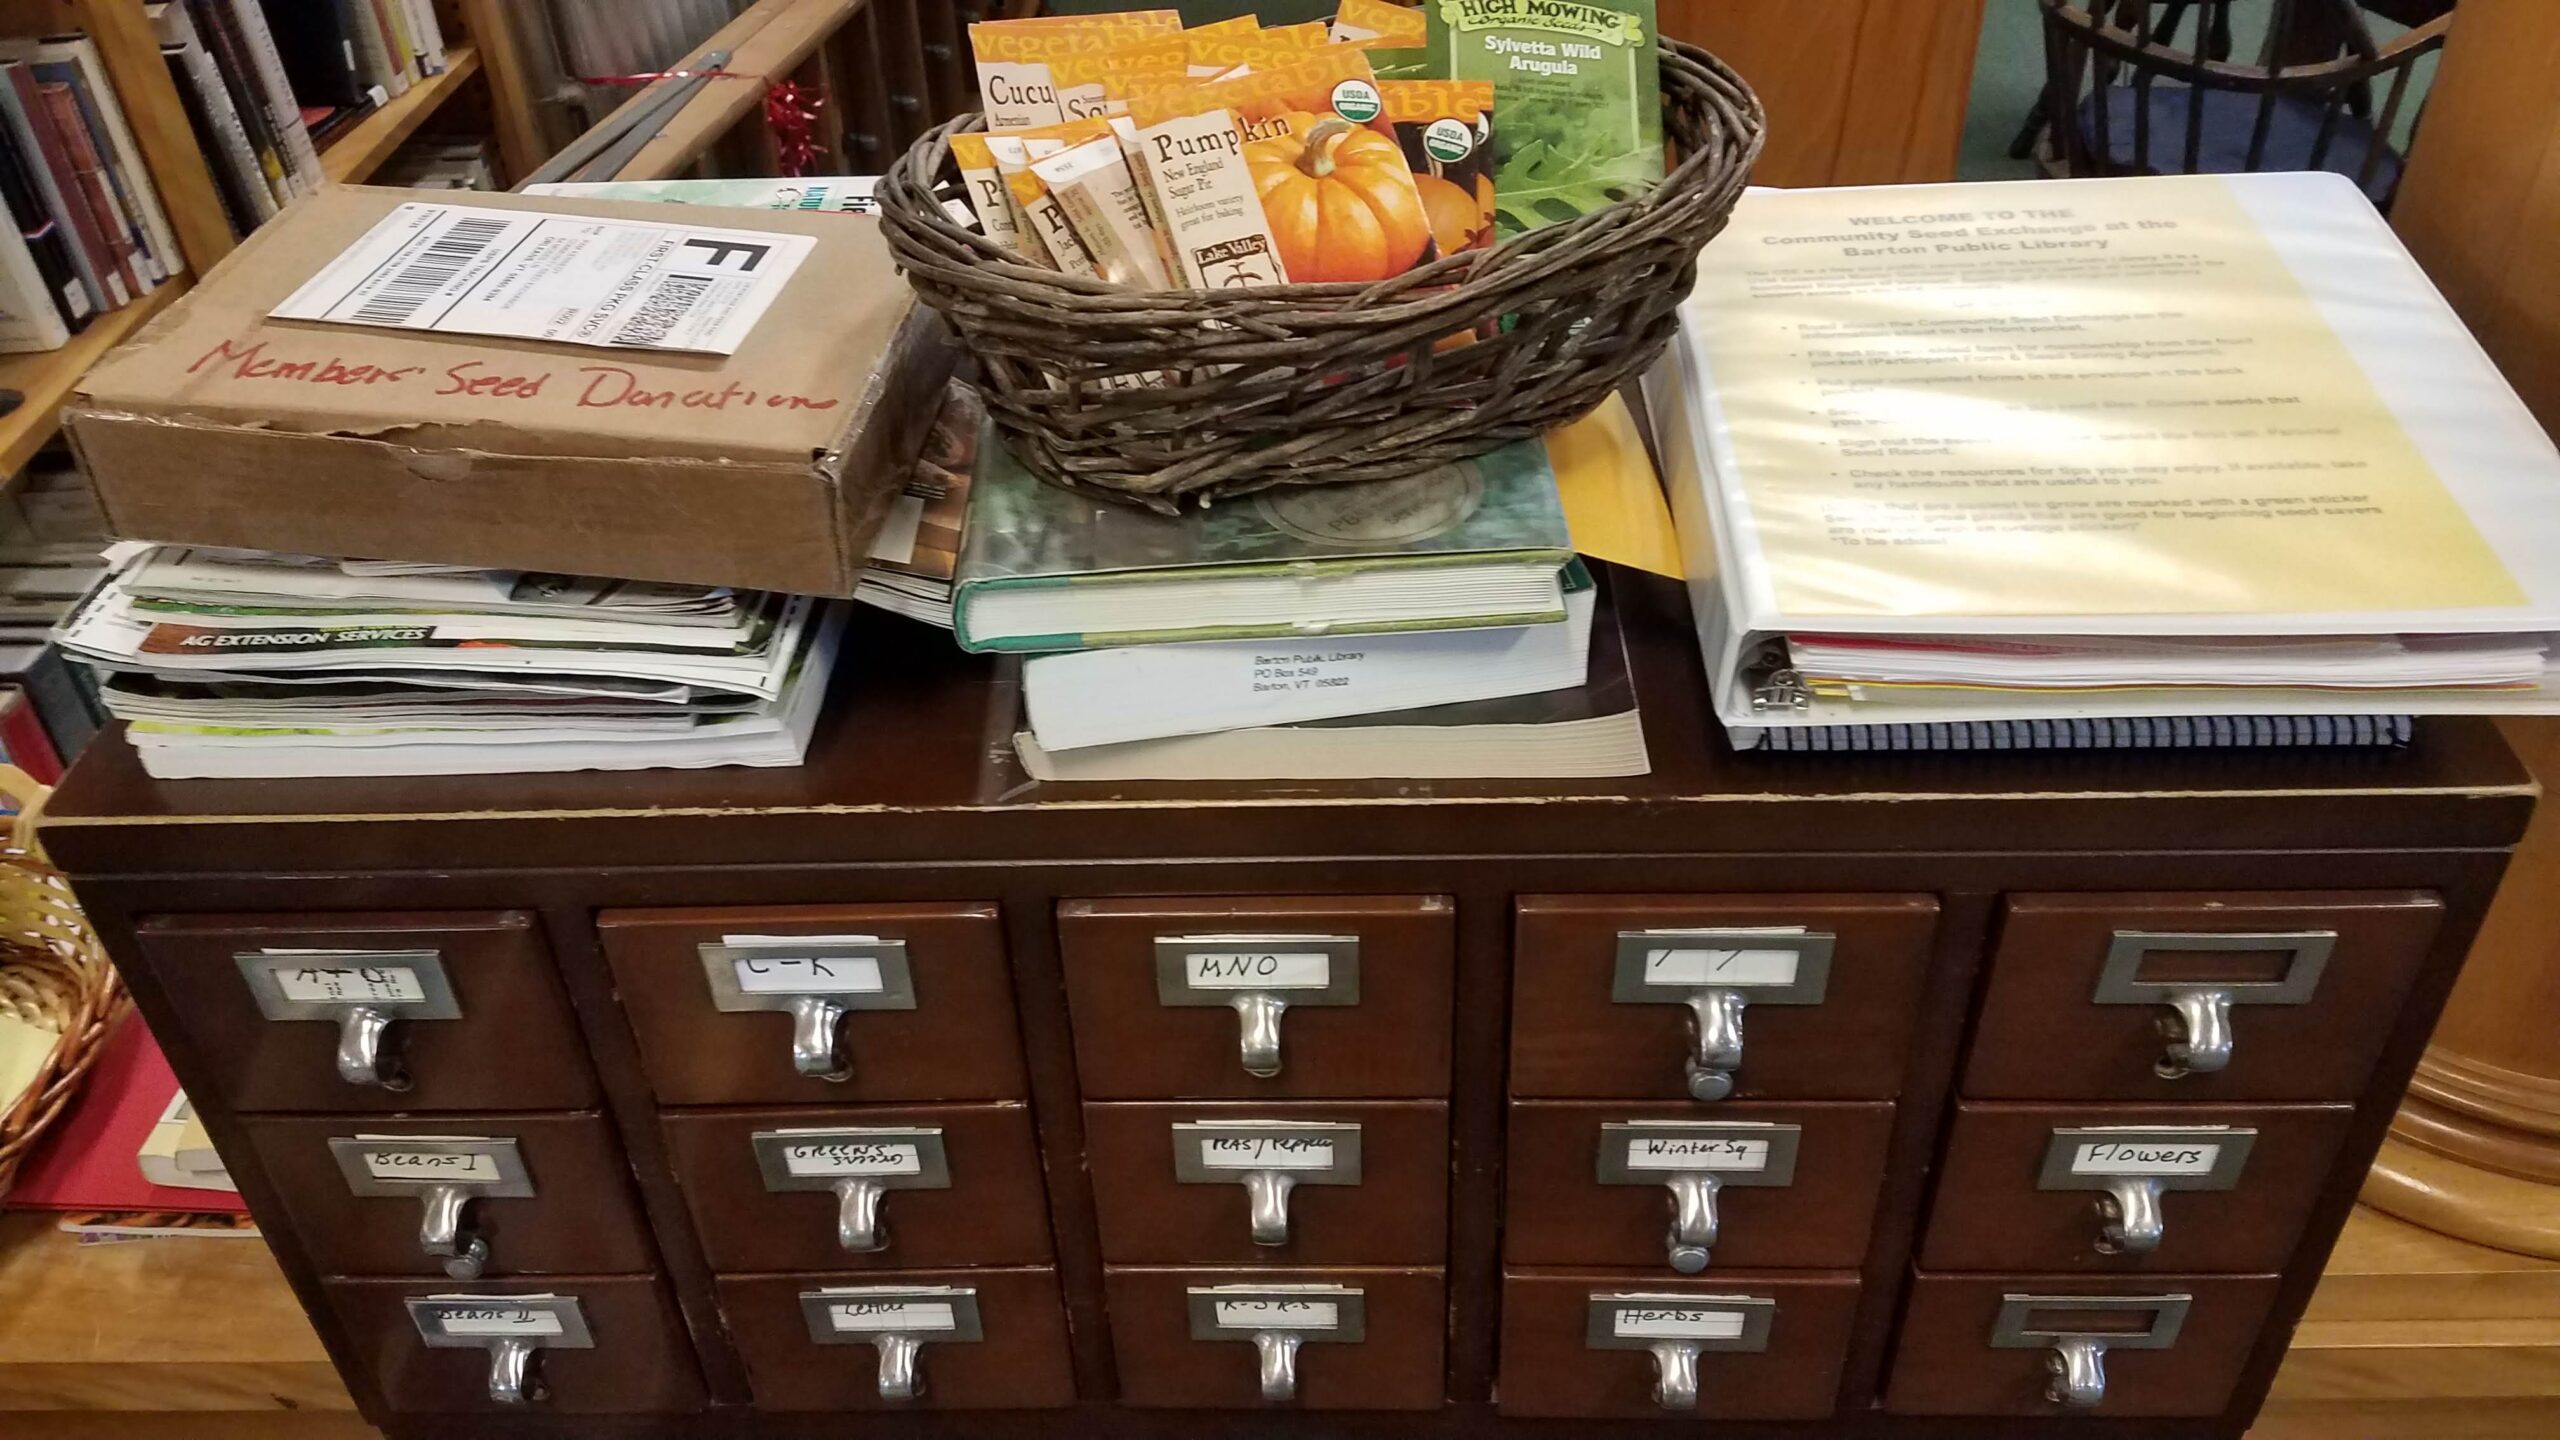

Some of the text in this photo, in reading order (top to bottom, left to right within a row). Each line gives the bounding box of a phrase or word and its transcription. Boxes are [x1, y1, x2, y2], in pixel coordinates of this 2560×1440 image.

[1460, 0, 1621, 29] HIGH MOWING
[1484, 35, 1602, 60] Sylvetta Wild
[1509, 55, 1578, 76] Arugula
[989, 75, 1055, 105] Cucu
[1342, 89, 1371, 100] USDA
[1152, 116, 1292, 163] Pumpkin
[1436, 126, 1464, 142] USDA
[1186, 157, 1225, 178] England
[1849, 208, 2074, 226] WELCOME TO THE
[1762, 220, 2178, 246] Community Seed Exchange at the
[666, 238, 772, 271] F
[1844, 238, 2108, 257] Barton Public Library
[615, 239, 676, 291] FIRST-CLASS
[597, 292, 629, 311] PKG
[435, 361, 553, 399] Seed
[1841, 447, 1956, 456] Seed Record.
[1850, 468, 1902, 478] Check
[1940, 468, 2025, 477] resources
[2029, 466, 2054, 475] for
[1888, 478, 1970, 488] handouts
[1975, 478, 2008, 487] that
[2046, 477, 2098, 486] useful
[179, 629, 427, 647] AG EXTENSION SERVICES
[1255, 655, 1289, 665] Barton
[1327, 651, 1365, 662] Library
[1254, 669, 1272, 678] PO
[1274, 668, 1294, 678] Box
[1294, 679, 1310, 689] VT
[1648, 1139, 1748, 1161] Winter Sq
[2088, 1144, 2202, 1164] Flowers
[374, 1153, 460, 1168] Beans
[1624, 1309, 1705, 1325] Herbs
